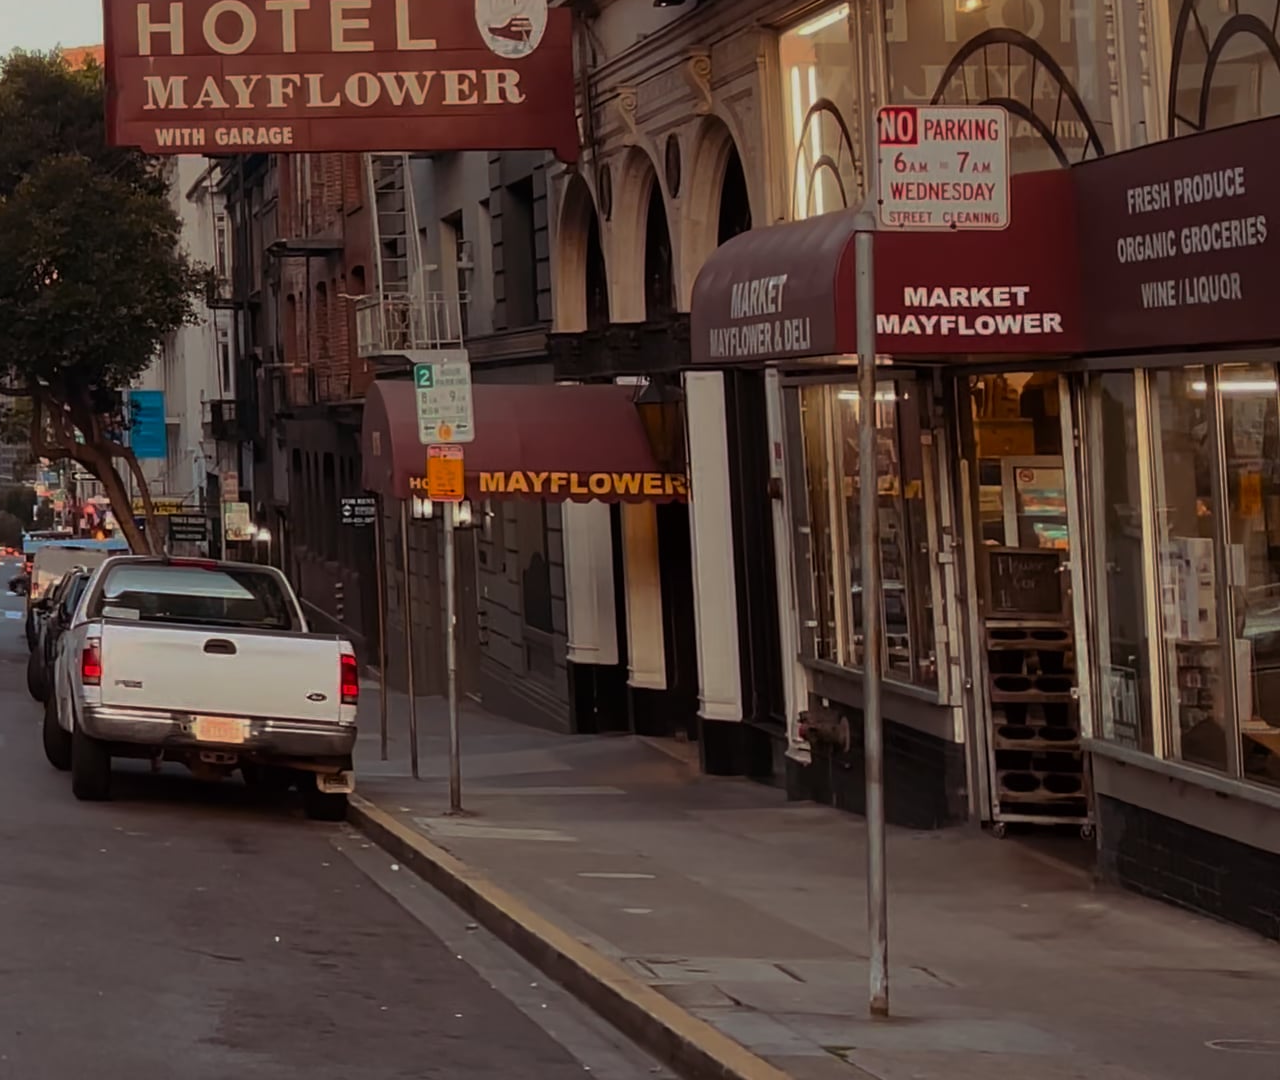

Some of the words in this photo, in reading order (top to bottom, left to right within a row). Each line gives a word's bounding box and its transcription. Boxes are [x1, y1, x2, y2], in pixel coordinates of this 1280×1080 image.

[142, 69, 527, 110] MAYFLOWER
[155, 128, 206, 147] WITH
[215, 126, 293, 146] GARAGE
[880, 110, 914, 142] NO
[923, 119, 999, 141] PARKING
[890, 182, 996, 201] WEDNESDAY
[1127, 181, 1171, 215] FRESH
[1174, 167, 1245, 206] PRODUCE
[889, 211, 933, 223] STREET
[942, 211, 1000, 224] CLEANING
[1117, 230, 1177, 263] ORGANIC
[1181, 215, 1268, 255] GROCERIES
[730, 273, 788, 319] MARKET
[904, 286, 1030, 308] MARKET
[1141, 279, 1176, 308] WINE
[1185, 272, 1242, 304] LIQUOR
[709, 323, 773, 358] MAYFLOWER
[774, 326, 783, 352] &
[784, 318, 811, 351] DELI
[876, 313, 1064, 335] MAYFLOWER
[419, 369, 431, 386] 2
[479, 471, 688, 495] MAYFLOWER
